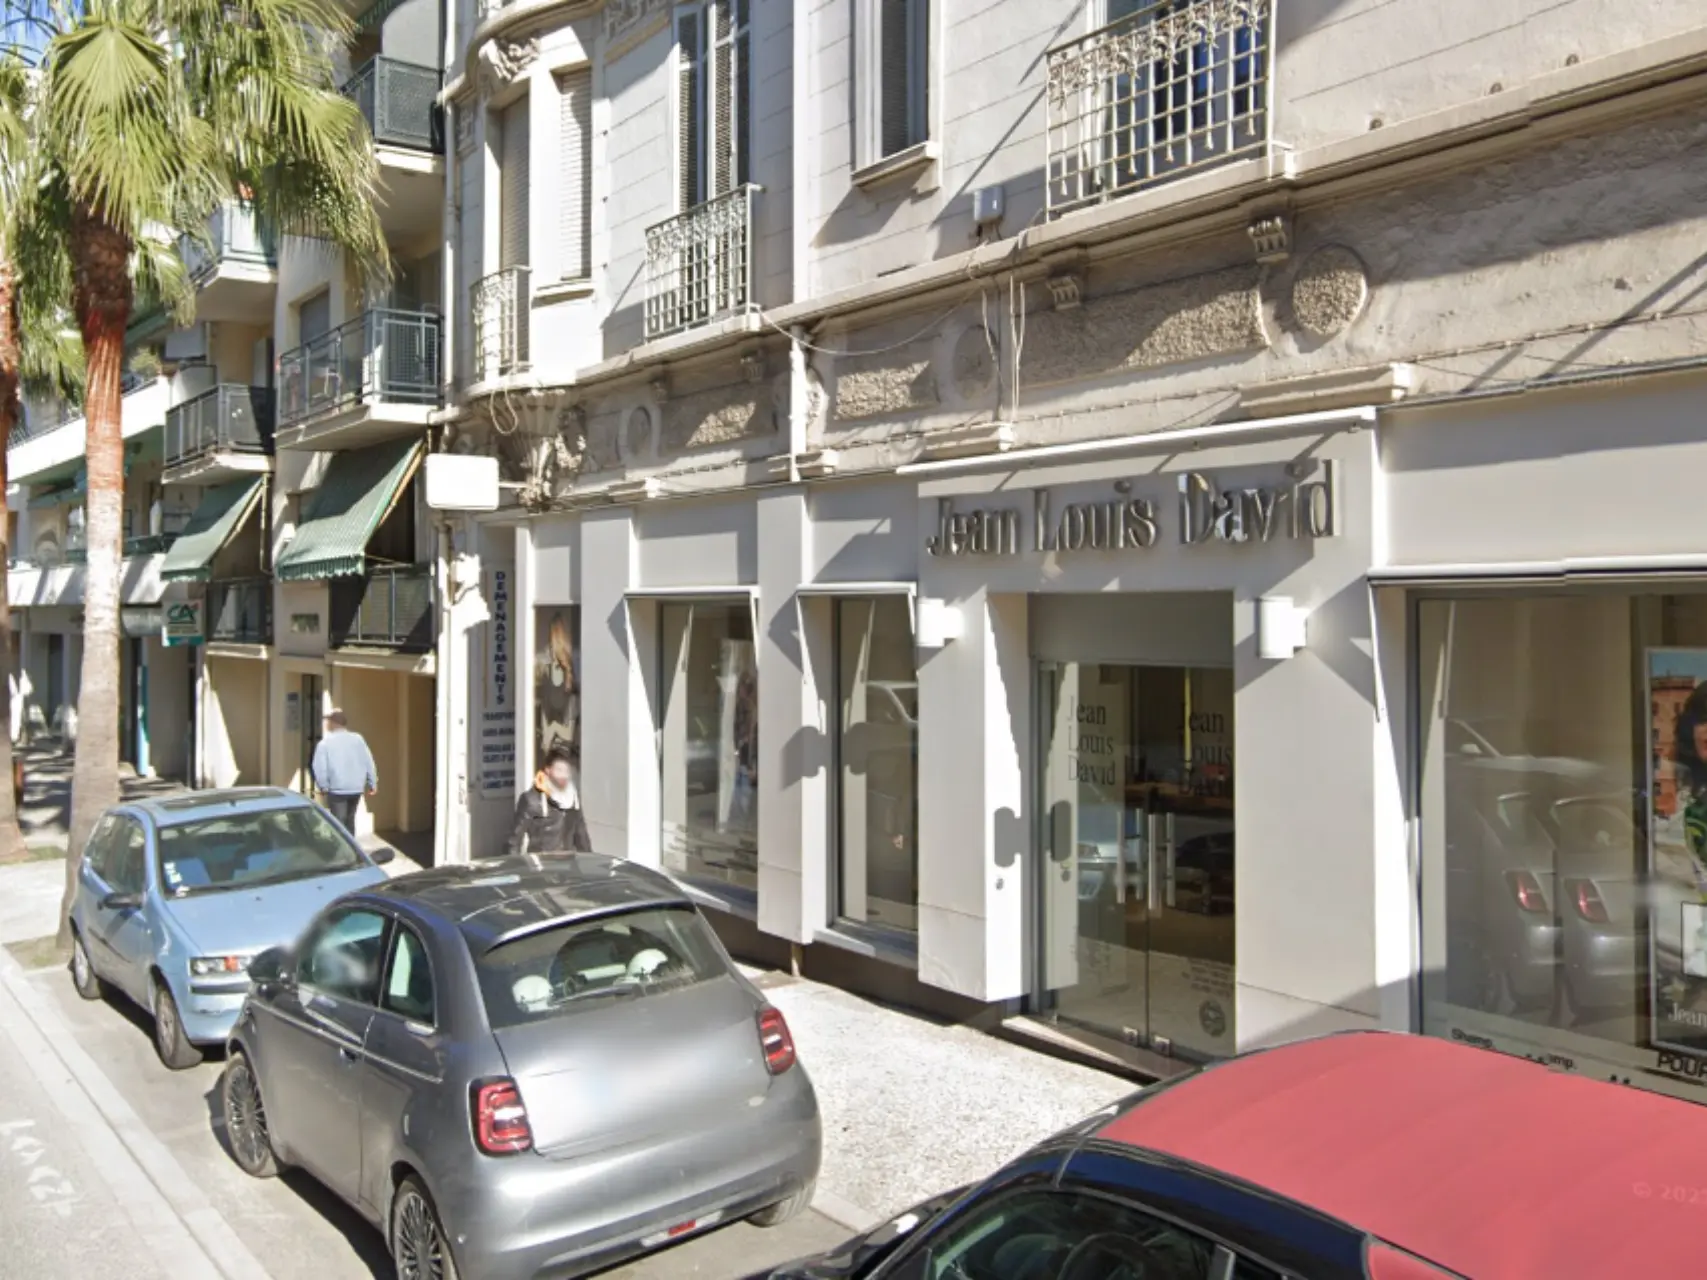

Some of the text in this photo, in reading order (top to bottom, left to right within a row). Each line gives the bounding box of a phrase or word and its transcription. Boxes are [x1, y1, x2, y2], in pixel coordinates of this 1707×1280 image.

[926, 457, 1341, 557] Jean Louis David
[494, 571, 508, 705] DEMENAGEMENTS
[1067, 694, 1106, 725] Jean
[1067, 724, 1114, 756] Louis
[1067, 754, 1116, 786] David
[1667, 1002, 1707, 1029] Jean
